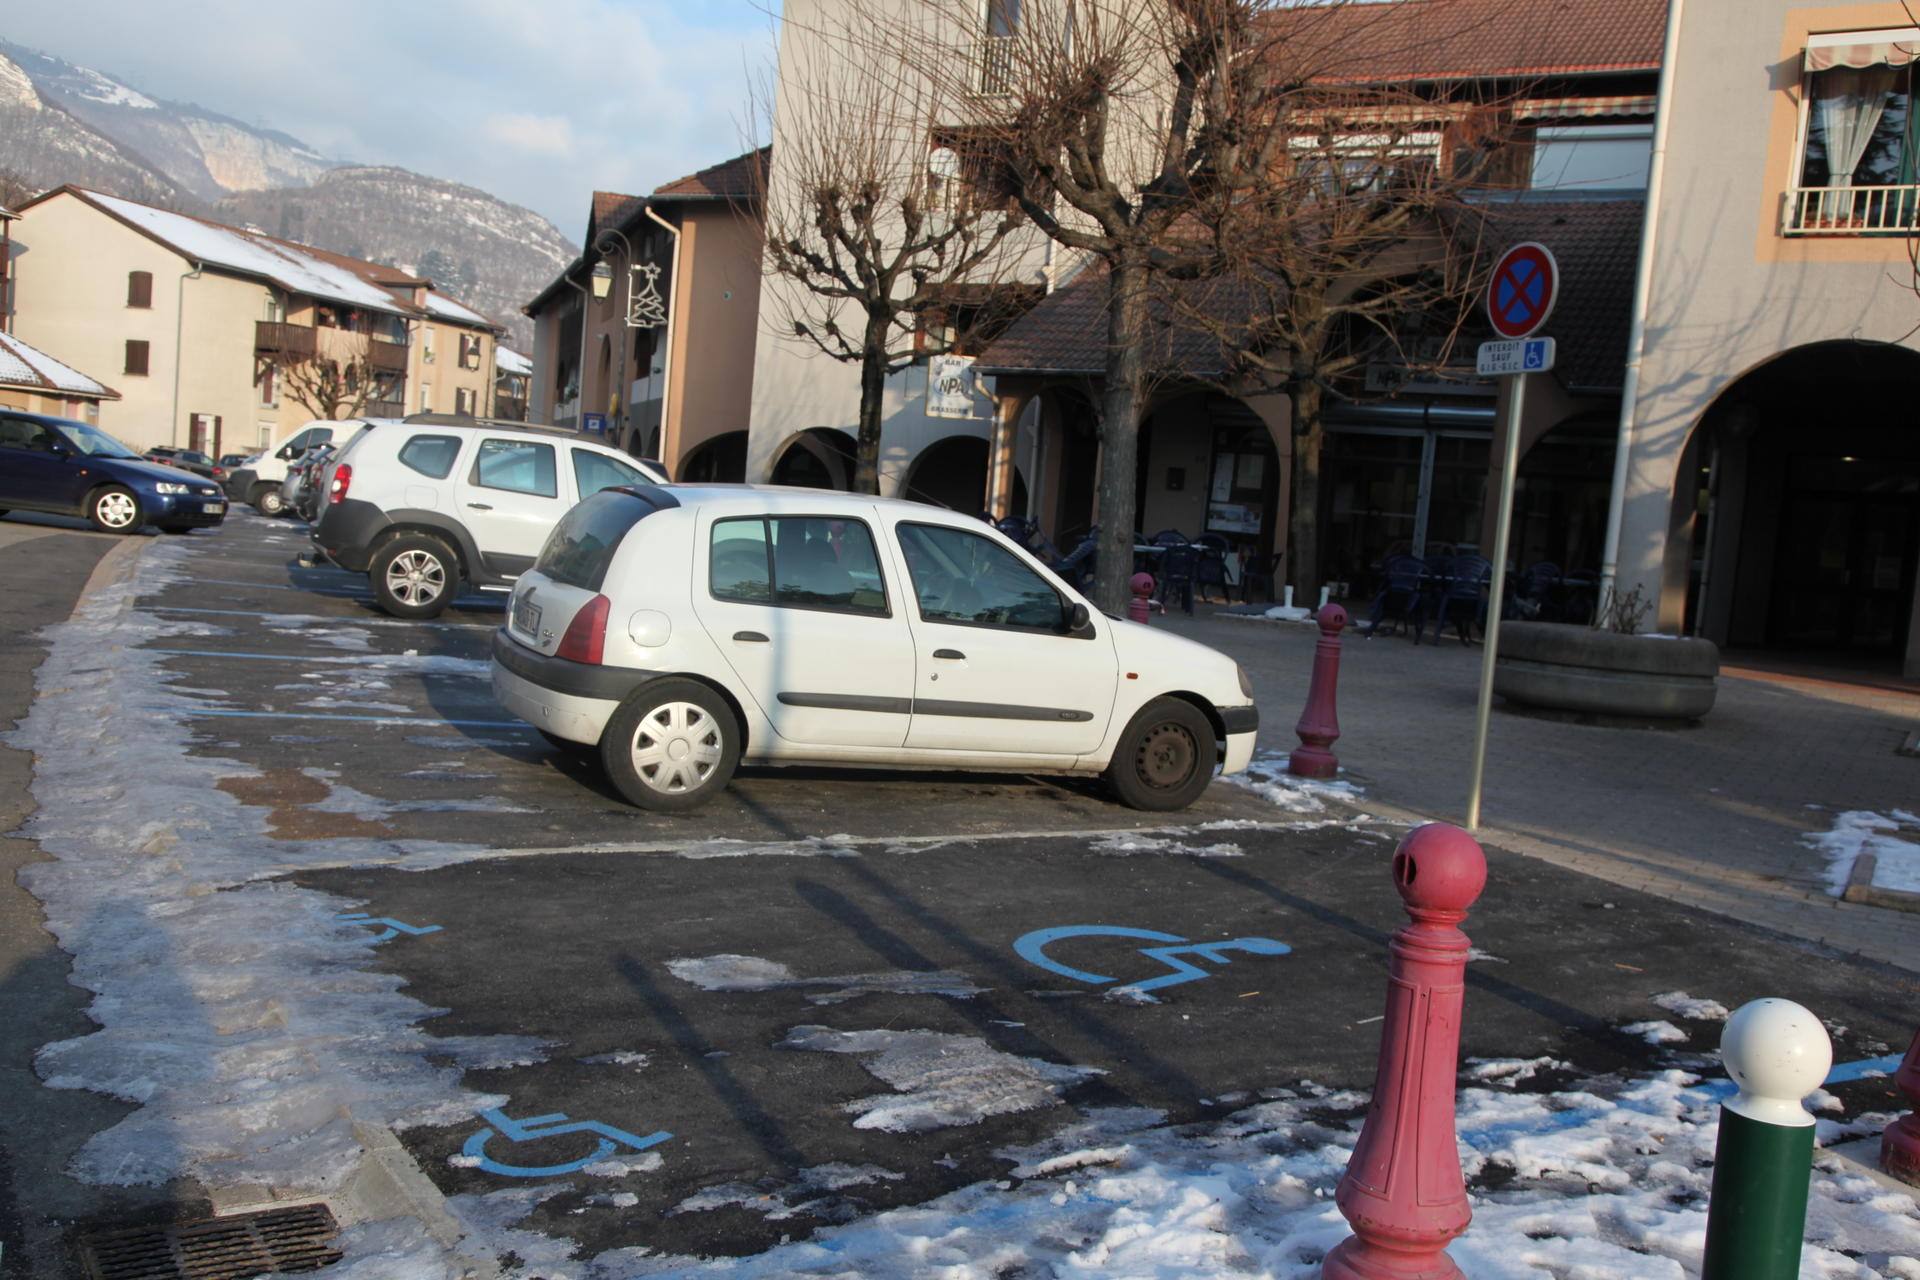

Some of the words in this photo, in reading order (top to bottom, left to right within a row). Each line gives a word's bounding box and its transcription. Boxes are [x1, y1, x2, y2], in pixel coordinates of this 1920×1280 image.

[1484, 341, 1520, 353] INTERDIT
[1491, 352, 1512, 362] SAUF
[939, 377, 965, 395] NPA
